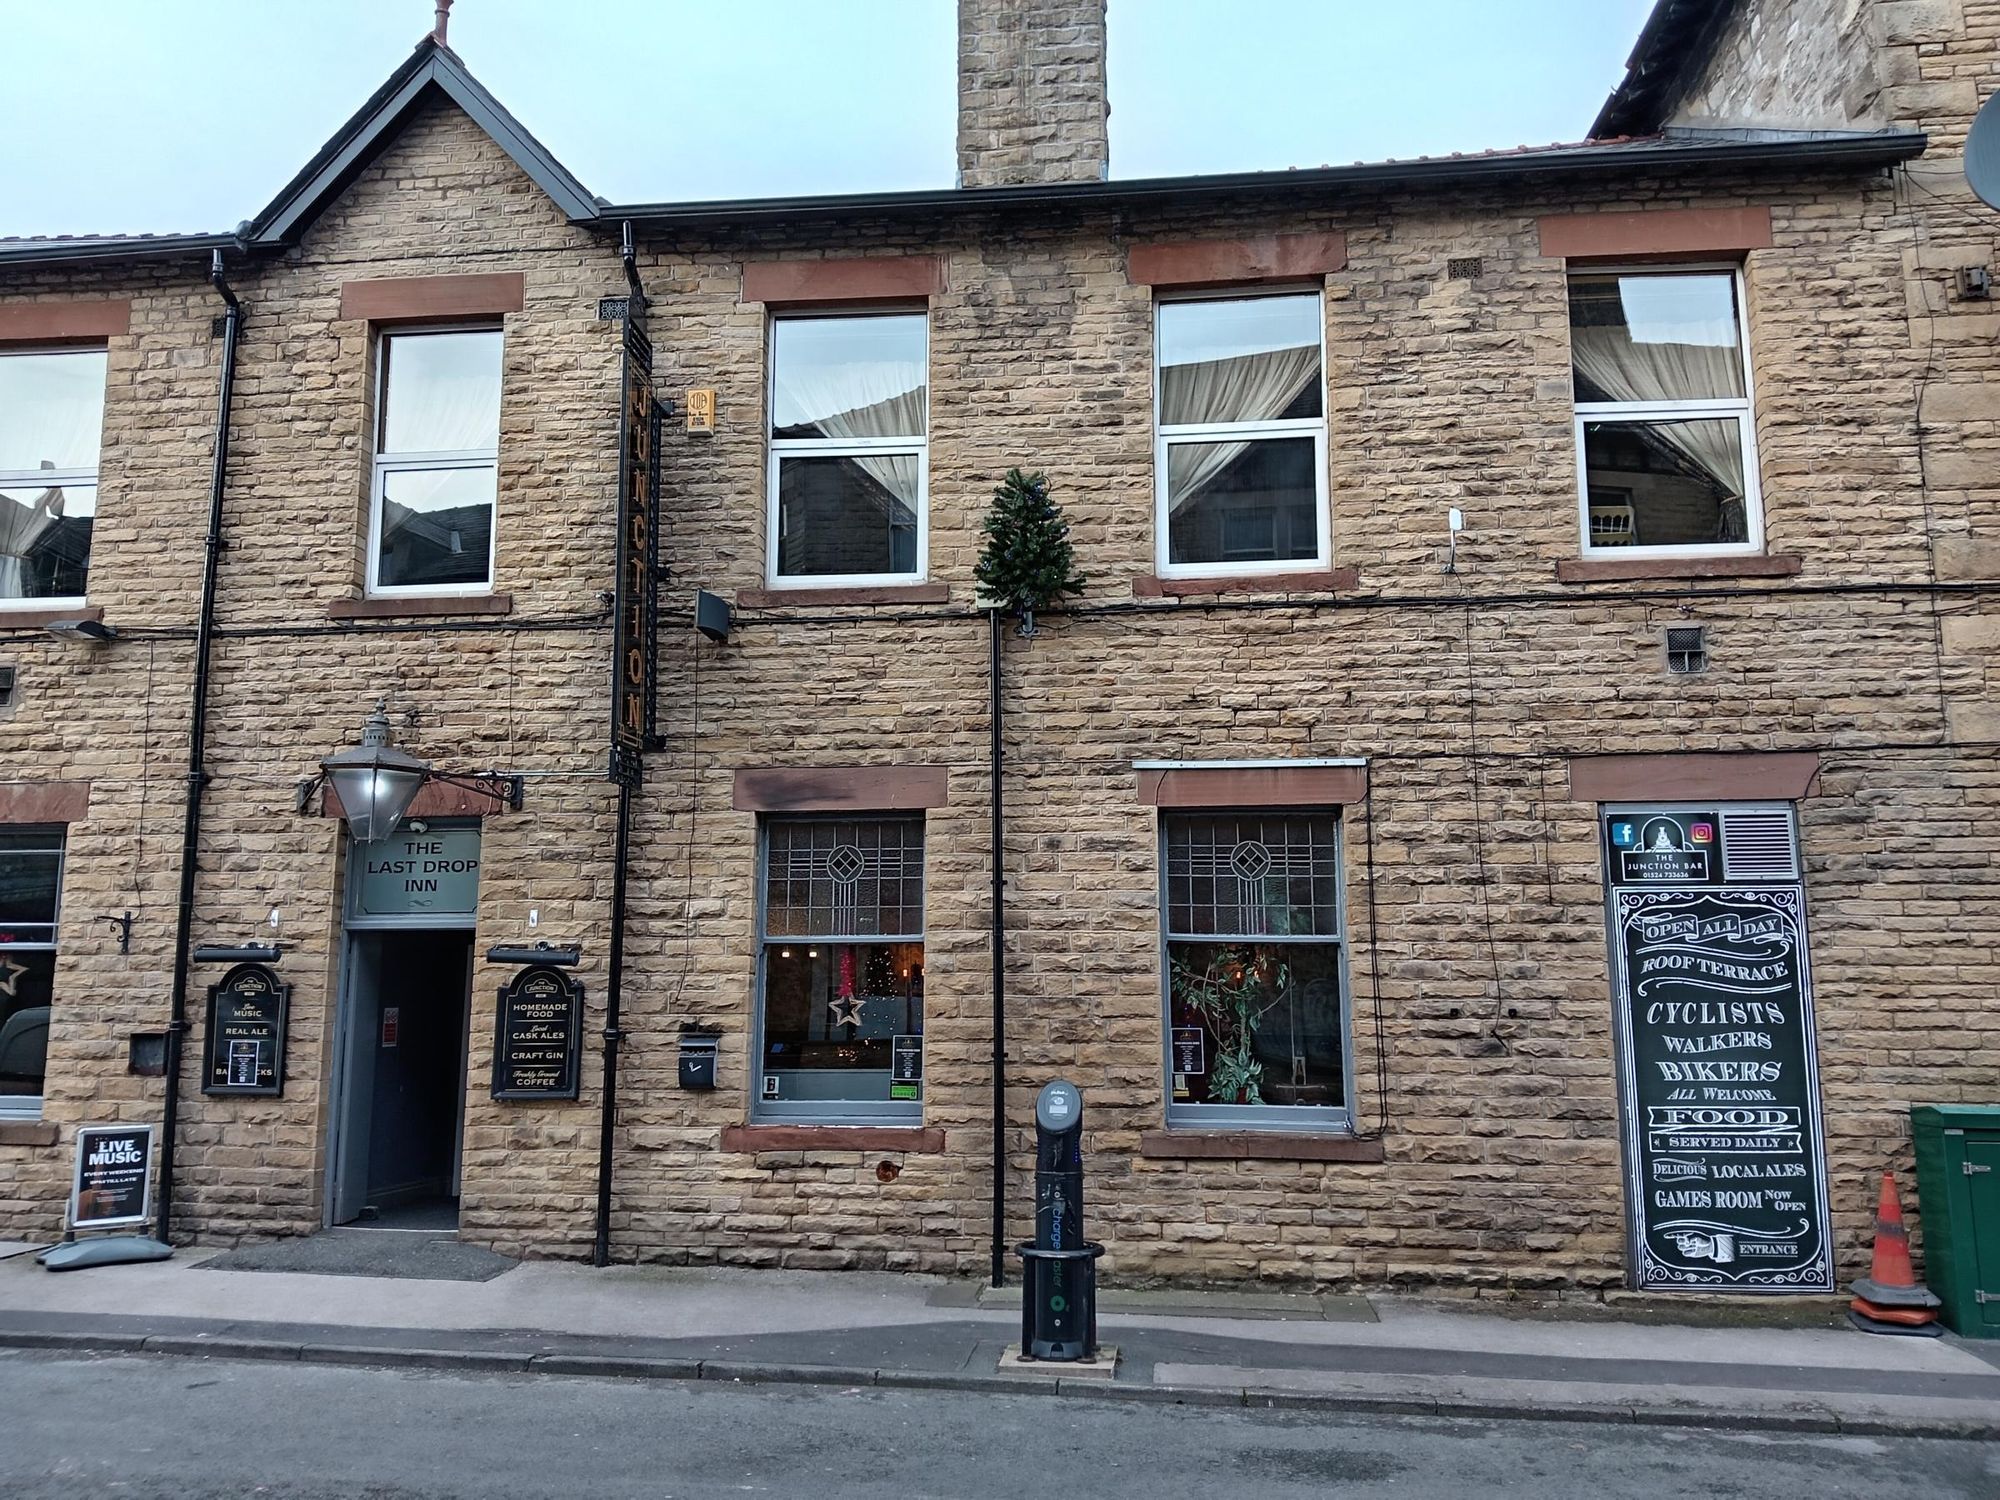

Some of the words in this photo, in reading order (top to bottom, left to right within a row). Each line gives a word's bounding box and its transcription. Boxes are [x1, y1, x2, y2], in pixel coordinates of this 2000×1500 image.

[629, 385, 648, 729] JUNCTION
[404, 842, 443, 855] THE
[367, 861, 417, 874] LAST
[423, 860, 478, 873] DROP
[1627, 862, 1679, 870] JUNCTION
[1684, 862, 1703, 870] BAR
[405, 879, 438, 892] INN
[1646, 919, 1695, 938] OPEN
[1703, 919, 1737, 936] ALL
[1744, 919, 1778, 935] DAY
[1640, 955, 1696, 974] ROOF
[1696, 957, 1788, 981] TERRACE
[1646, 1002, 1785, 1025] CYCLISTS
[1662, 1031, 1773, 1054] WALKERS
[511, 1052, 543, 1060] CRAFT
[1655, 1061, 1782, 1082] BIKERS
[1667, 1088, 1696, 1100] ALL
[1703, 1087, 1776, 1101] WELCOME
[1664, 1110, 1788, 1124] FOOD
[98, 1140, 135, 1153] LIVE
[1669, 1136, 1732, 1148] SERVED
[1735, 1137, 1781, 1148] DAILY
[89, 1151, 142, 1166] MUSIC
[108, 1168, 144, 1176] WEEKEND
[1653, 1163, 1707, 1176] DELICIOUS
[1711, 1164, 1764, 1179] LOCAL
[1765, 1163, 1806, 1177] ALES
[1655, 1190, 1712, 1208] GAMES
[1715, 1190, 1763, 1209] ROOM
[1765, 1189, 1792, 1200] NOW
[1774, 1200, 1806, 1211] OPEN
[1050, 1208, 1063, 1288] chargeaster
[1740, 1244, 1798, 1255] ENTRANCE
